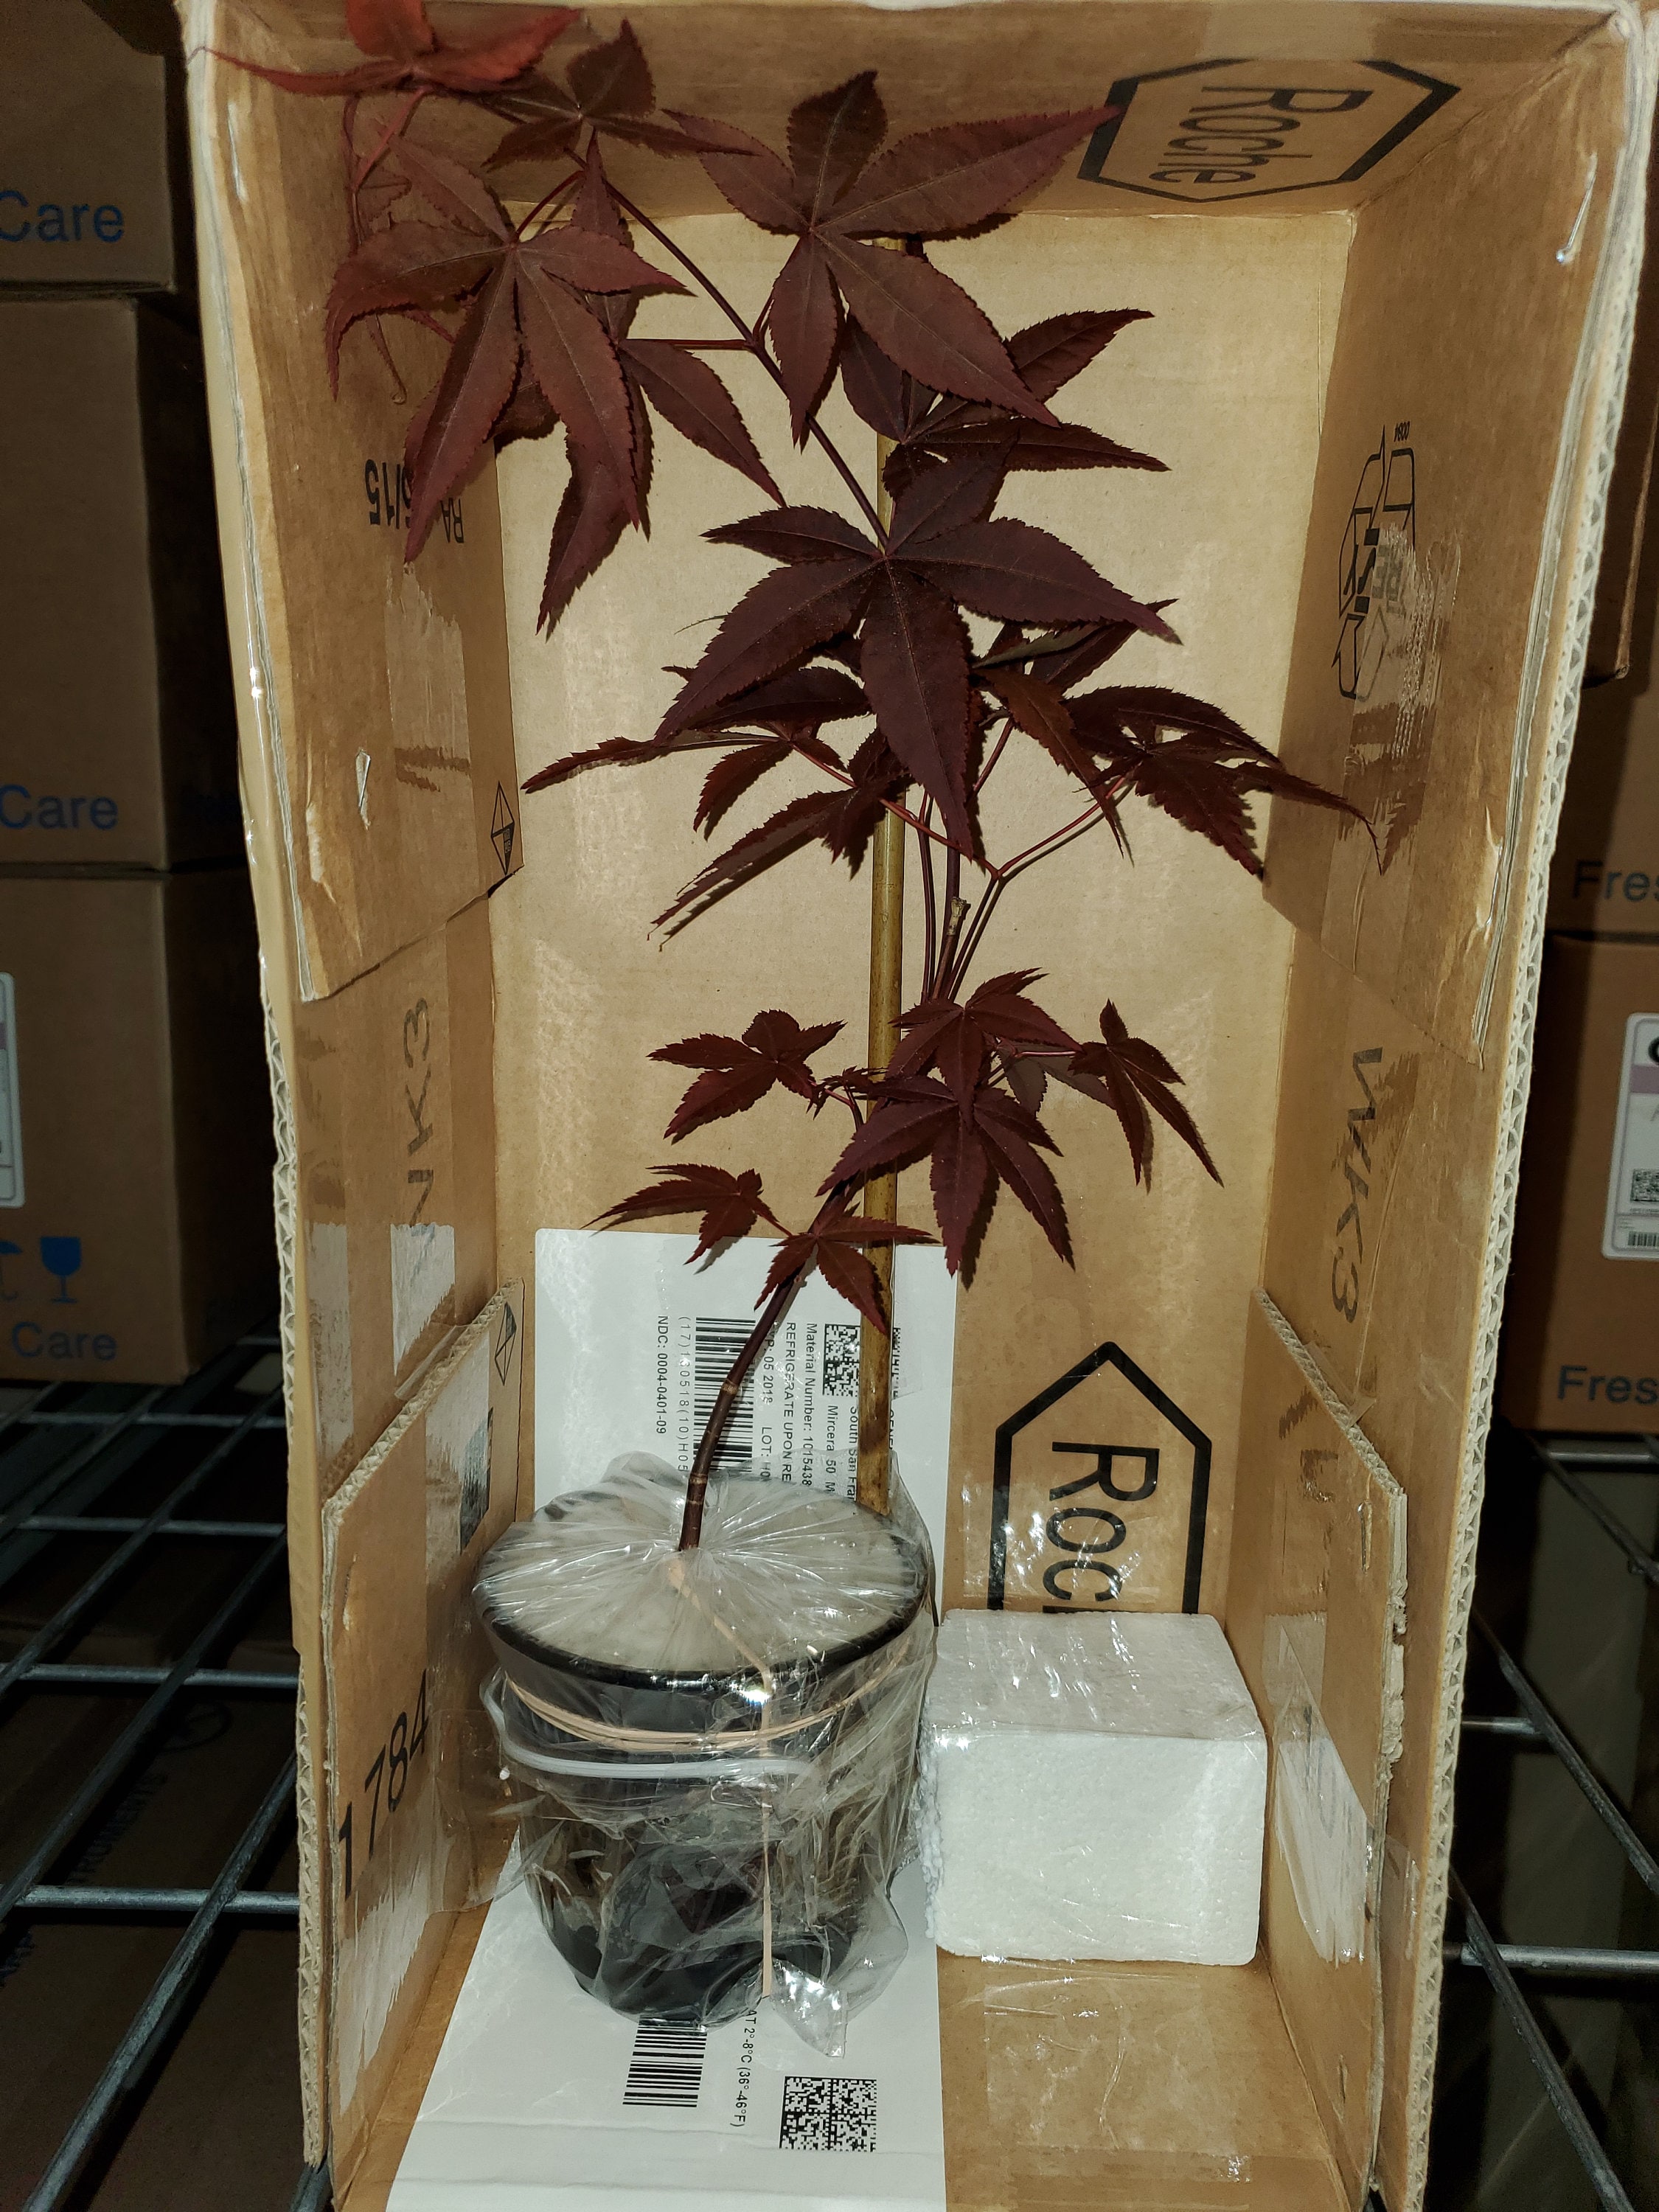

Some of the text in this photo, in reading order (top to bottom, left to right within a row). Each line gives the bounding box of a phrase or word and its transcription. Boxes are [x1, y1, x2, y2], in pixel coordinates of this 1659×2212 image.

[1149, 86, 1374, 184] Roche
[0, 189, 125, 243] Care
[0, 783, 119, 830] Care
[1572, 860, 1659, 902] Fre
[11, 1321, 118, 1362] Care
[764, 1356, 774, 1370] 05
[805, 1323, 818, 1373] Material
[656, 1315, 669, 1434] NDC: 0004-0401-09
[783, 1321, 796, 1417] REFRIGERATE
[803, 1377, 815, 1431] Number:
[849, 1405, 859, 1444] South
[761, 1426, 772, 1457] LOT:
[782, 1422, 794, 1460] UPON
[826, 1405, 838, 1451] Mircera
[826, 1459, 837, 1474] 50
[847, 1448, 858, 1472] San
[1042, 1441, 1160, 1614] Roc
[338, 1669, 430, 1902] 1784
